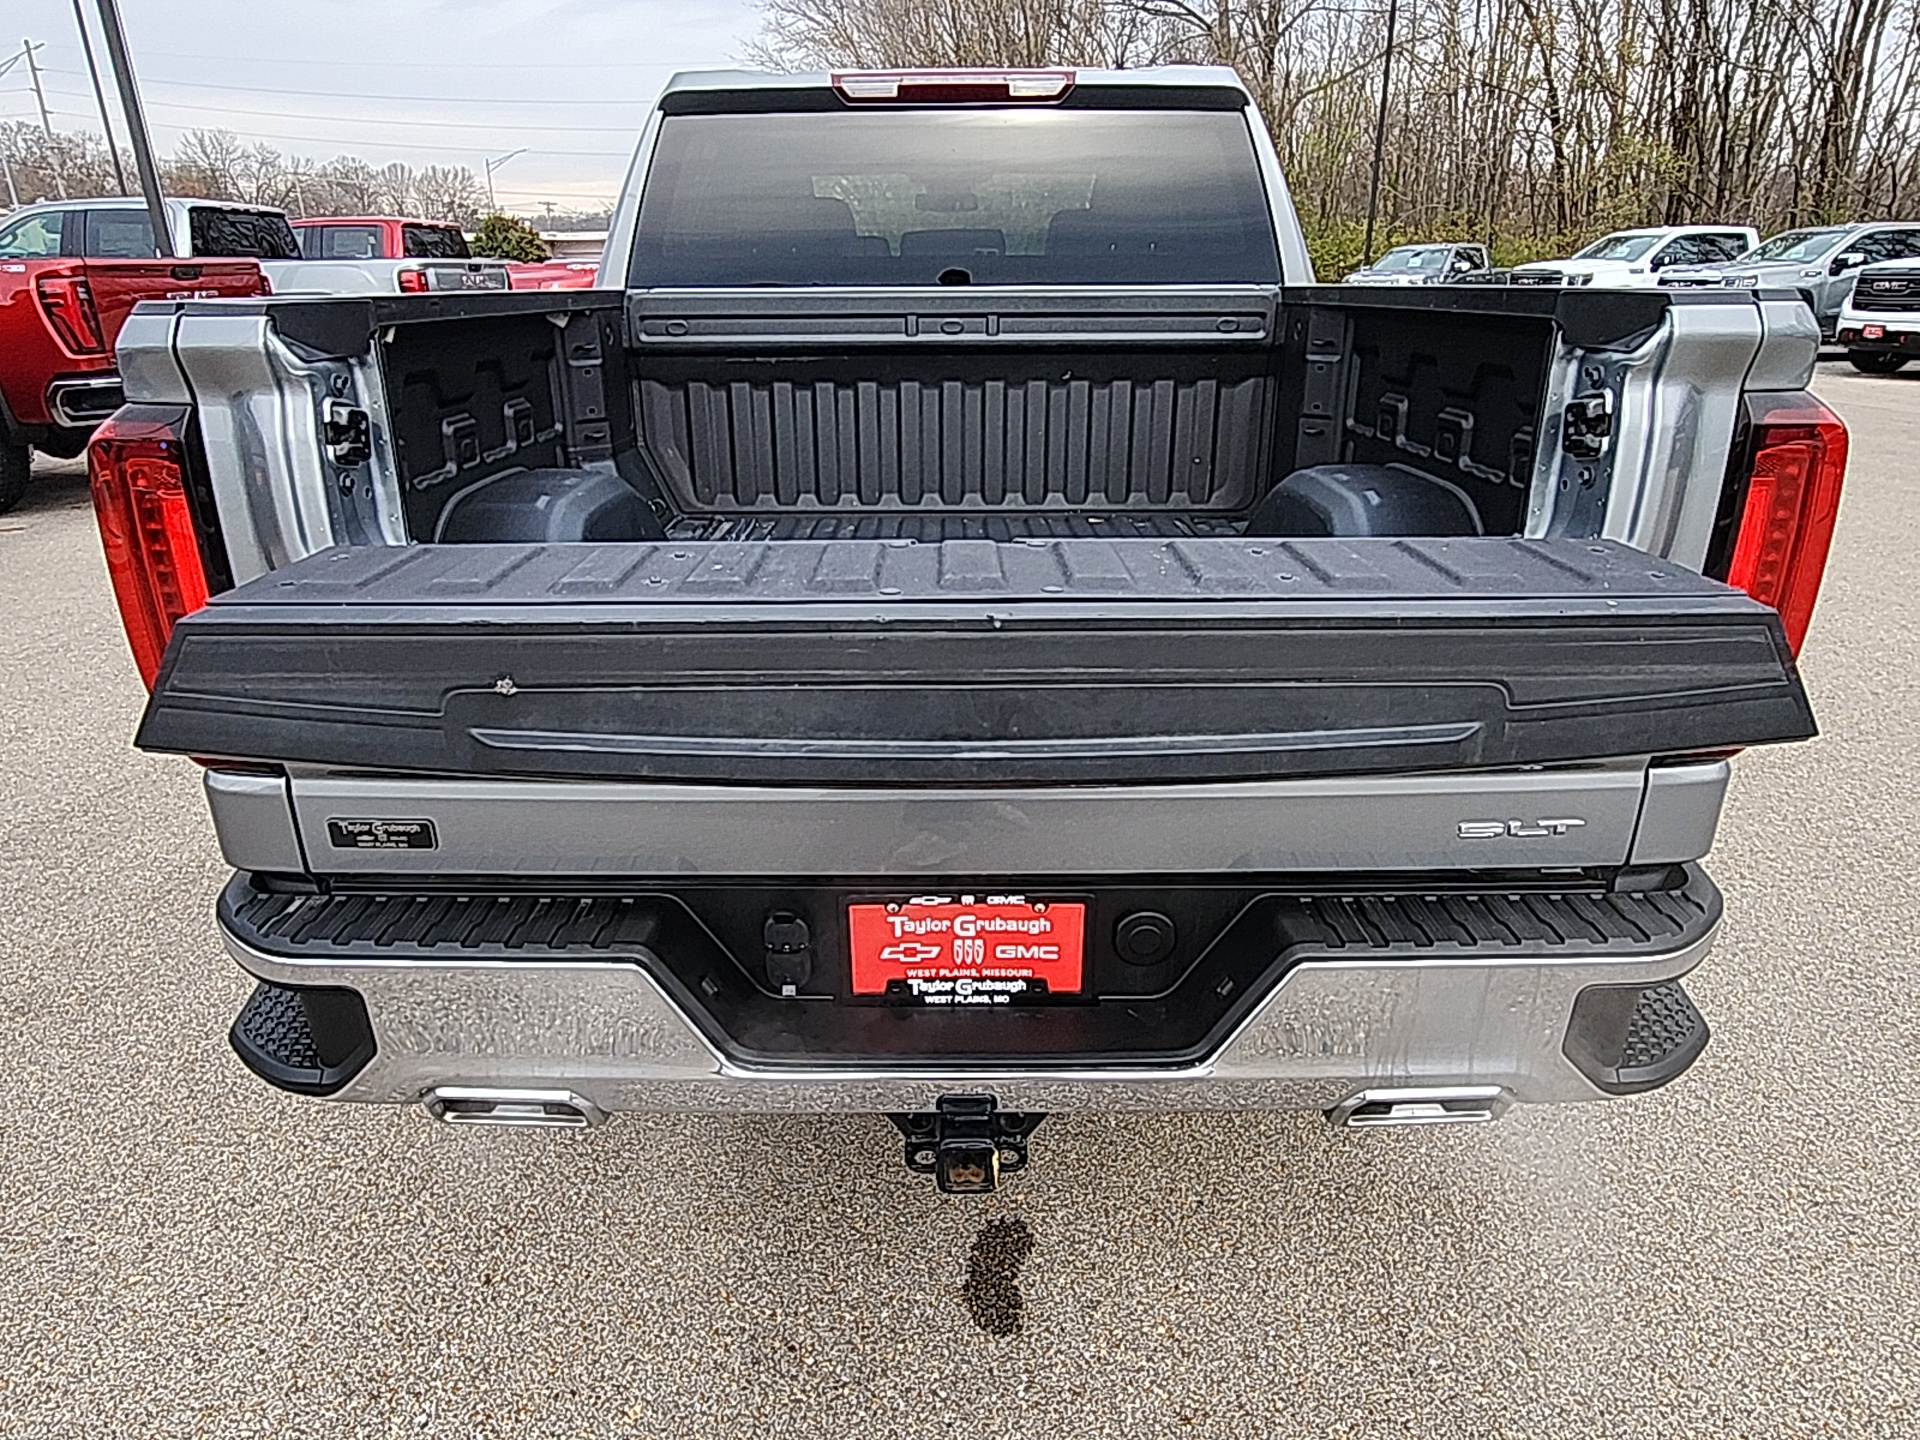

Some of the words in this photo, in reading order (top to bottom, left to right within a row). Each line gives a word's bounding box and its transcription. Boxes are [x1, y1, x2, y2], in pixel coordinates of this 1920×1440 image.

[1458, 818, 1587, 838] SLT
[886, 916, 951, 938] Taylor
[953, 915, 1051, 937] Grubaugh
[995, 945, 1060, 960] GMC
[906, 968, 937, 978] WEST
[939, 968, 980, 978] PLAINS,
[981, 968, 1033, 978] MISSOURI
[906, 979, 954, 996] Taylor
[955, 978, 1027, 995] Grubaugh
[924, 995, 953, 1004] WEST
